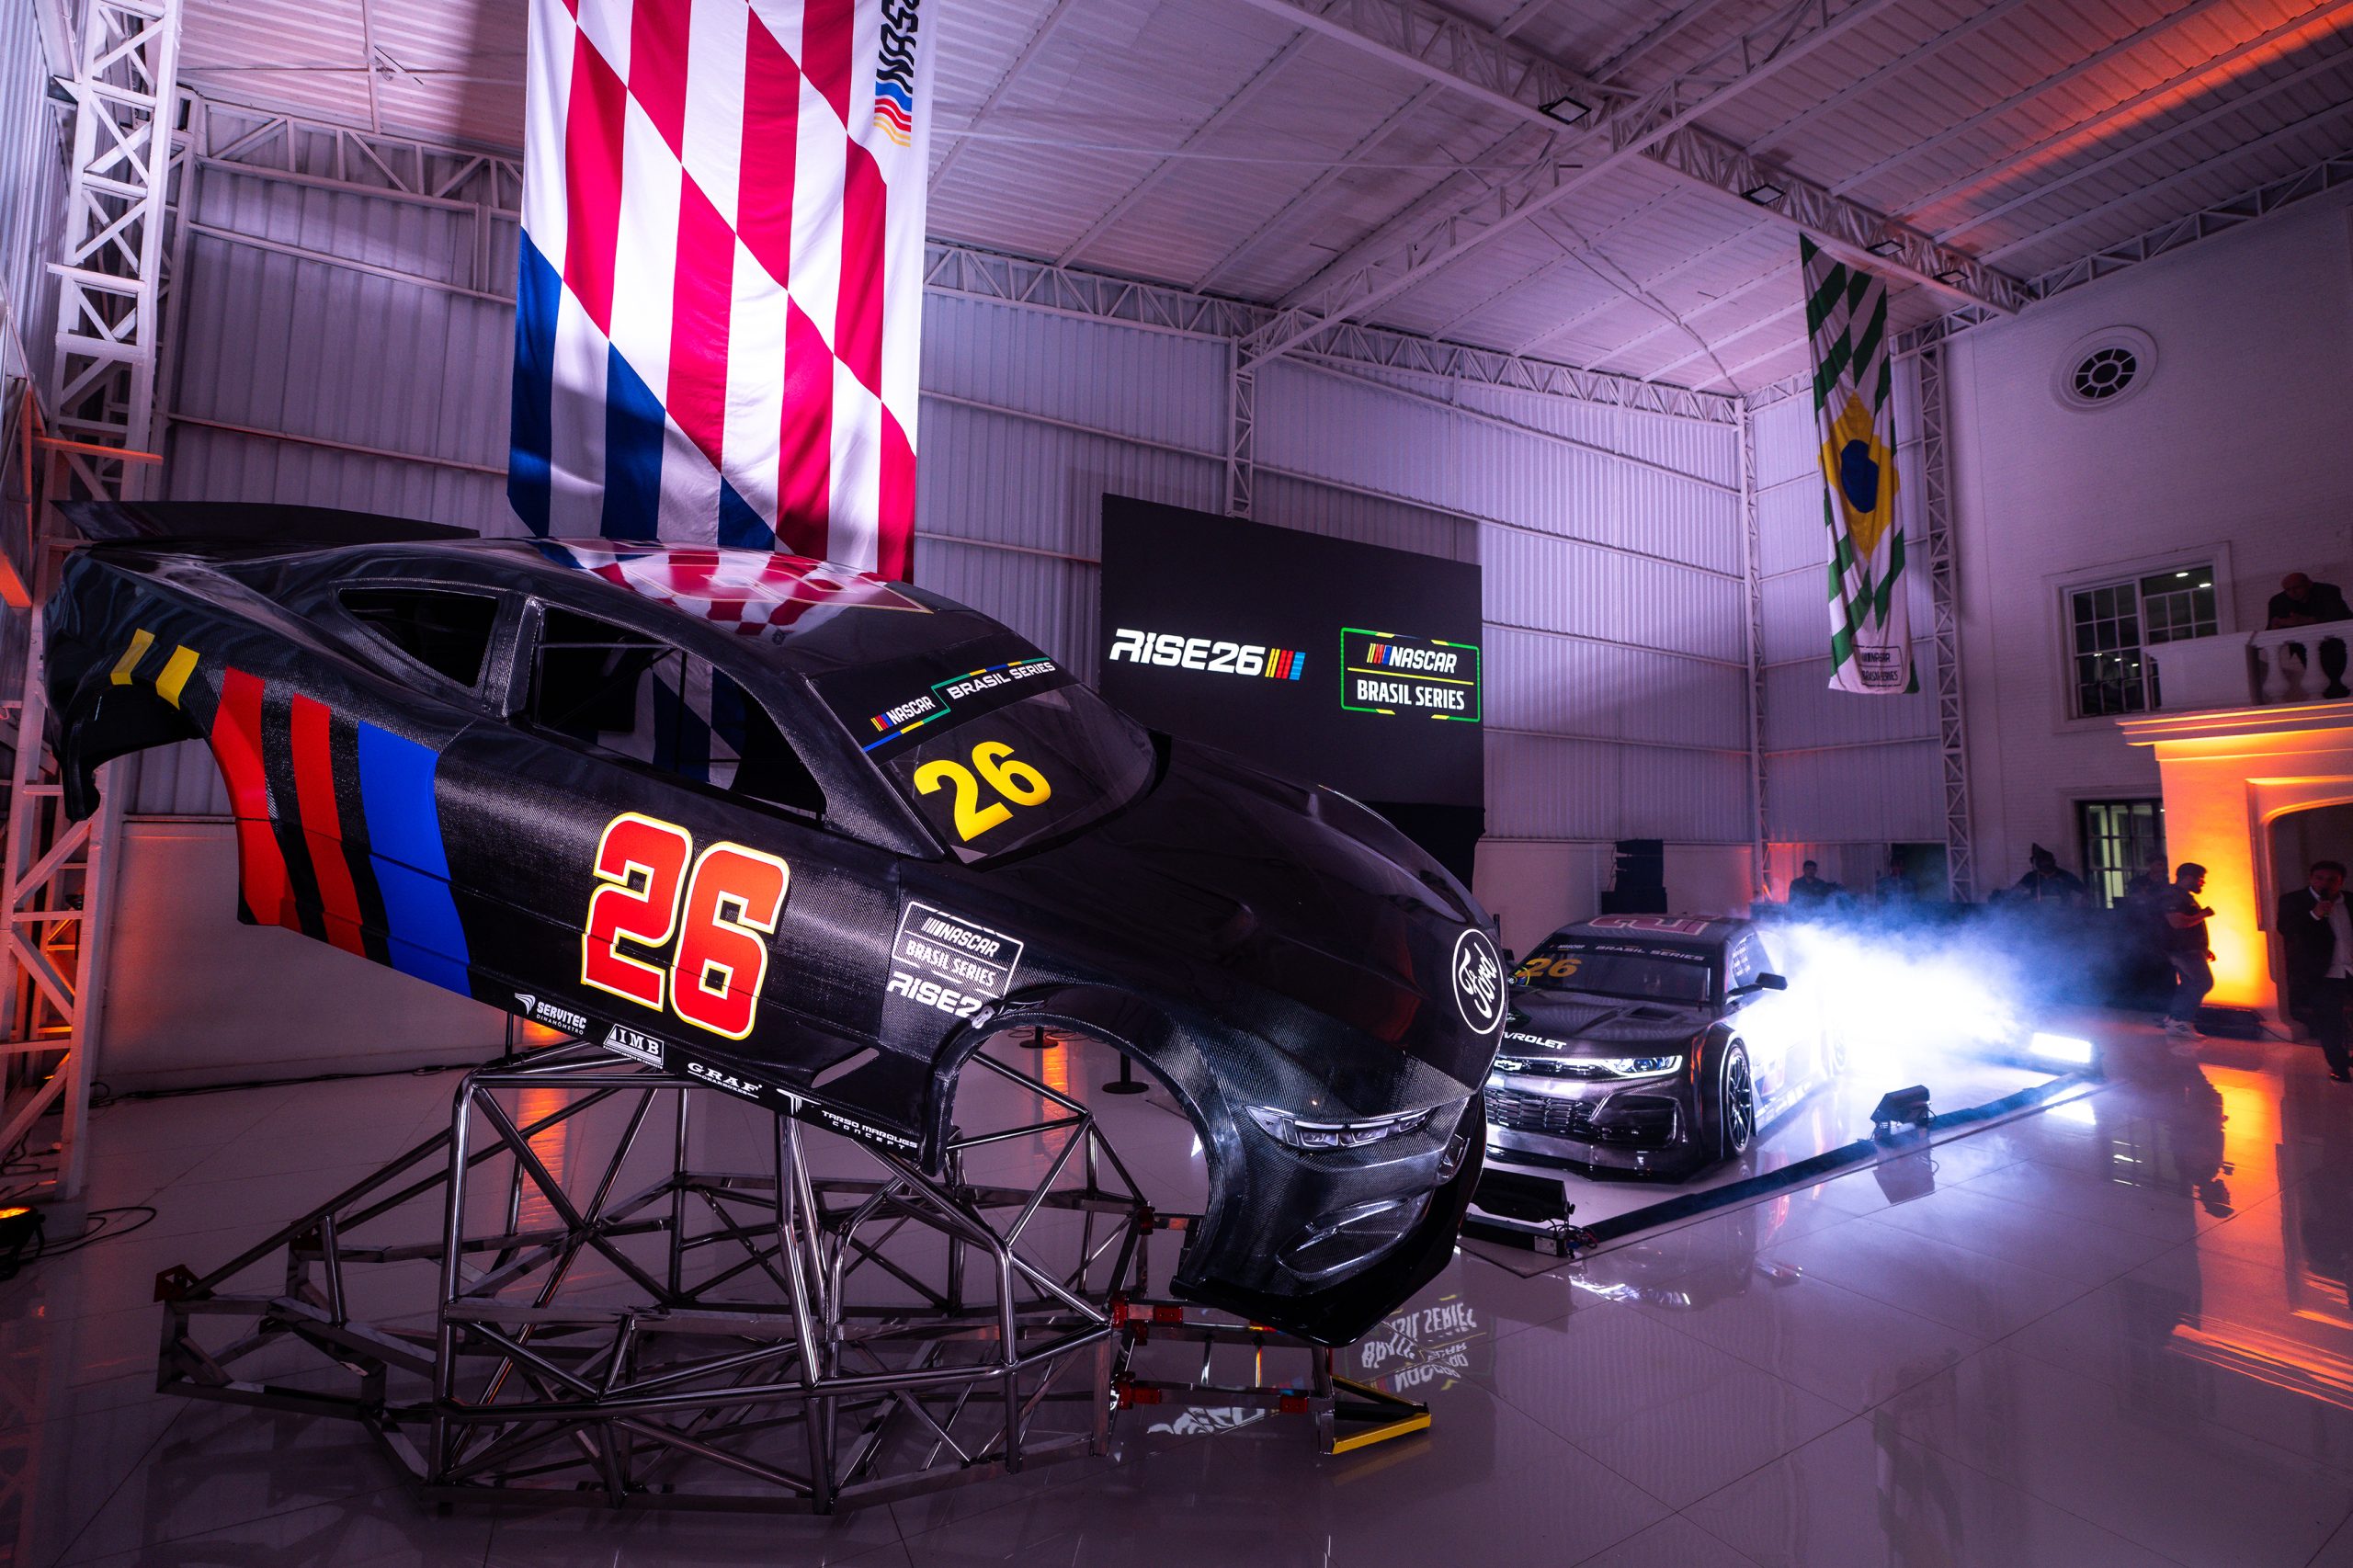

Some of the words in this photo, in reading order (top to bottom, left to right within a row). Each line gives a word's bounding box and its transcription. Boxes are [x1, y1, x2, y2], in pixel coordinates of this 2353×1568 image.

[1108, 628, 1267, 676] RISE26
[1389, 645, 1458, 674] NASCAR
[946, 672, 1012, 700] BRASIL
[1008, 662, 1056, 680] SERIES
[1357, 679, 1412, 705] BRASIL
[1415, 686, 1465, 710] SERIES
[885, 695, 937, 725] NASCAR
[914, 741, 1051, 842] 26
[580, 812, 790, 1041] 26
[939, 921, 1001, 958] NASCAR
[905, 939, 950, 971] BRASIL
[951, 957, 996, 988] SERIES
[1520, 958, 1582, 978] 26
[1596, 945, 1646, 955] BRASIL
[1650, 949, 1707, 961] SERIES
[887, 971, 983, 1019] RISE2
[1458, 941, 1497, 1019] Ford
[536, 1001, 587, 1030] SERVITEC
[620, 1028, 659, 1056] IMB
[1503, 1031, 1567, 1050] VROLET
[688, 1062, 759, 1092] GRAF
[821, 1109, 859, 1129] TARSO
[861, 1124, 918, 1149] MARQUES
[832, 1120, 905, 1150] CONCEPT
